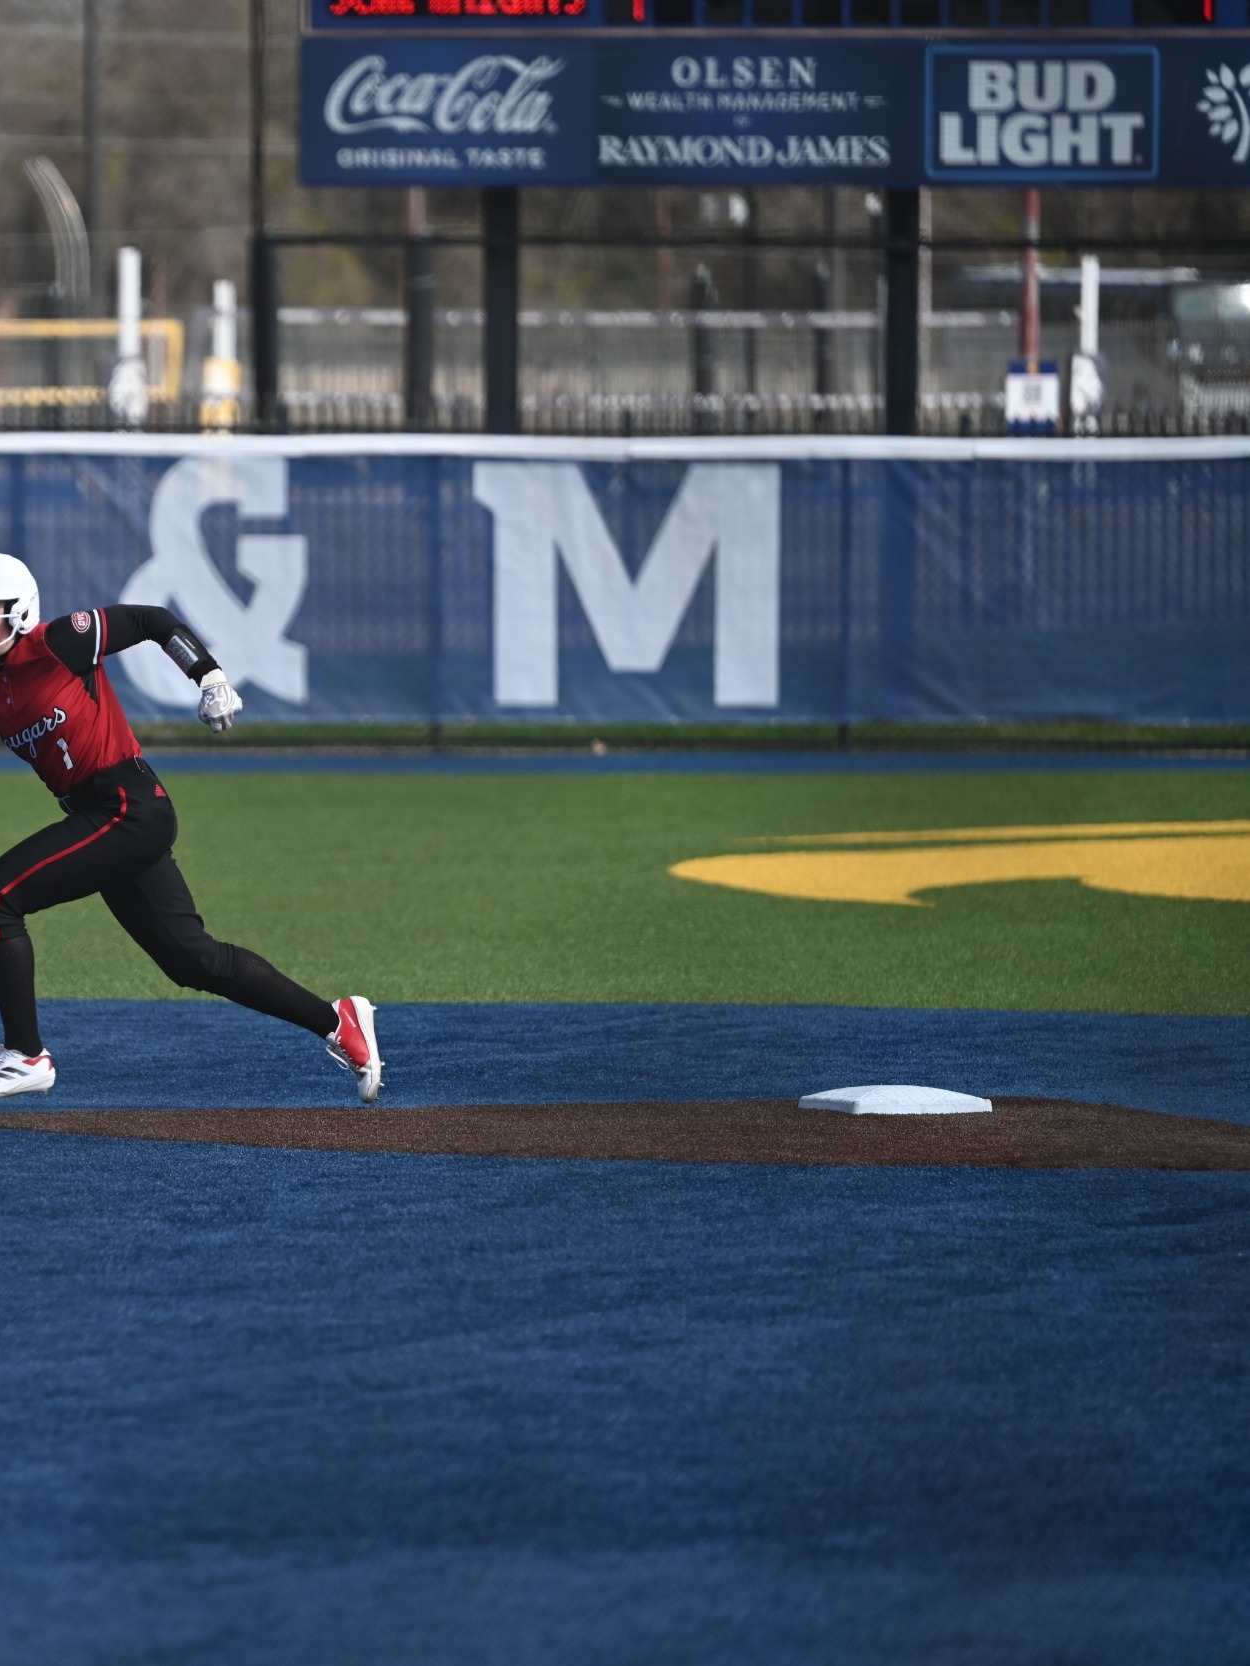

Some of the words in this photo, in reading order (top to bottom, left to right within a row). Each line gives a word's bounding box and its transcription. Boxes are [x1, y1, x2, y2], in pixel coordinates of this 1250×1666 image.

[670, 56, 817, 88] OLSEN
[968, 60, 1116, 112] BUD
[627, 91, 713, 112] WEALTH
[716, 91, 858, 112] MANAGEMENT
[597, 134, 775, 167] RAYMOND
[775, 134, 892, 167] JAMES
[939, 112, 1144, 165] LIGHT
[336, 147, 462, 169] ORIGINAL
[467, 147, 547, 169] TASTE
[4, 707, 67, 759] ougars
[57, 738, 74, 770] 1
